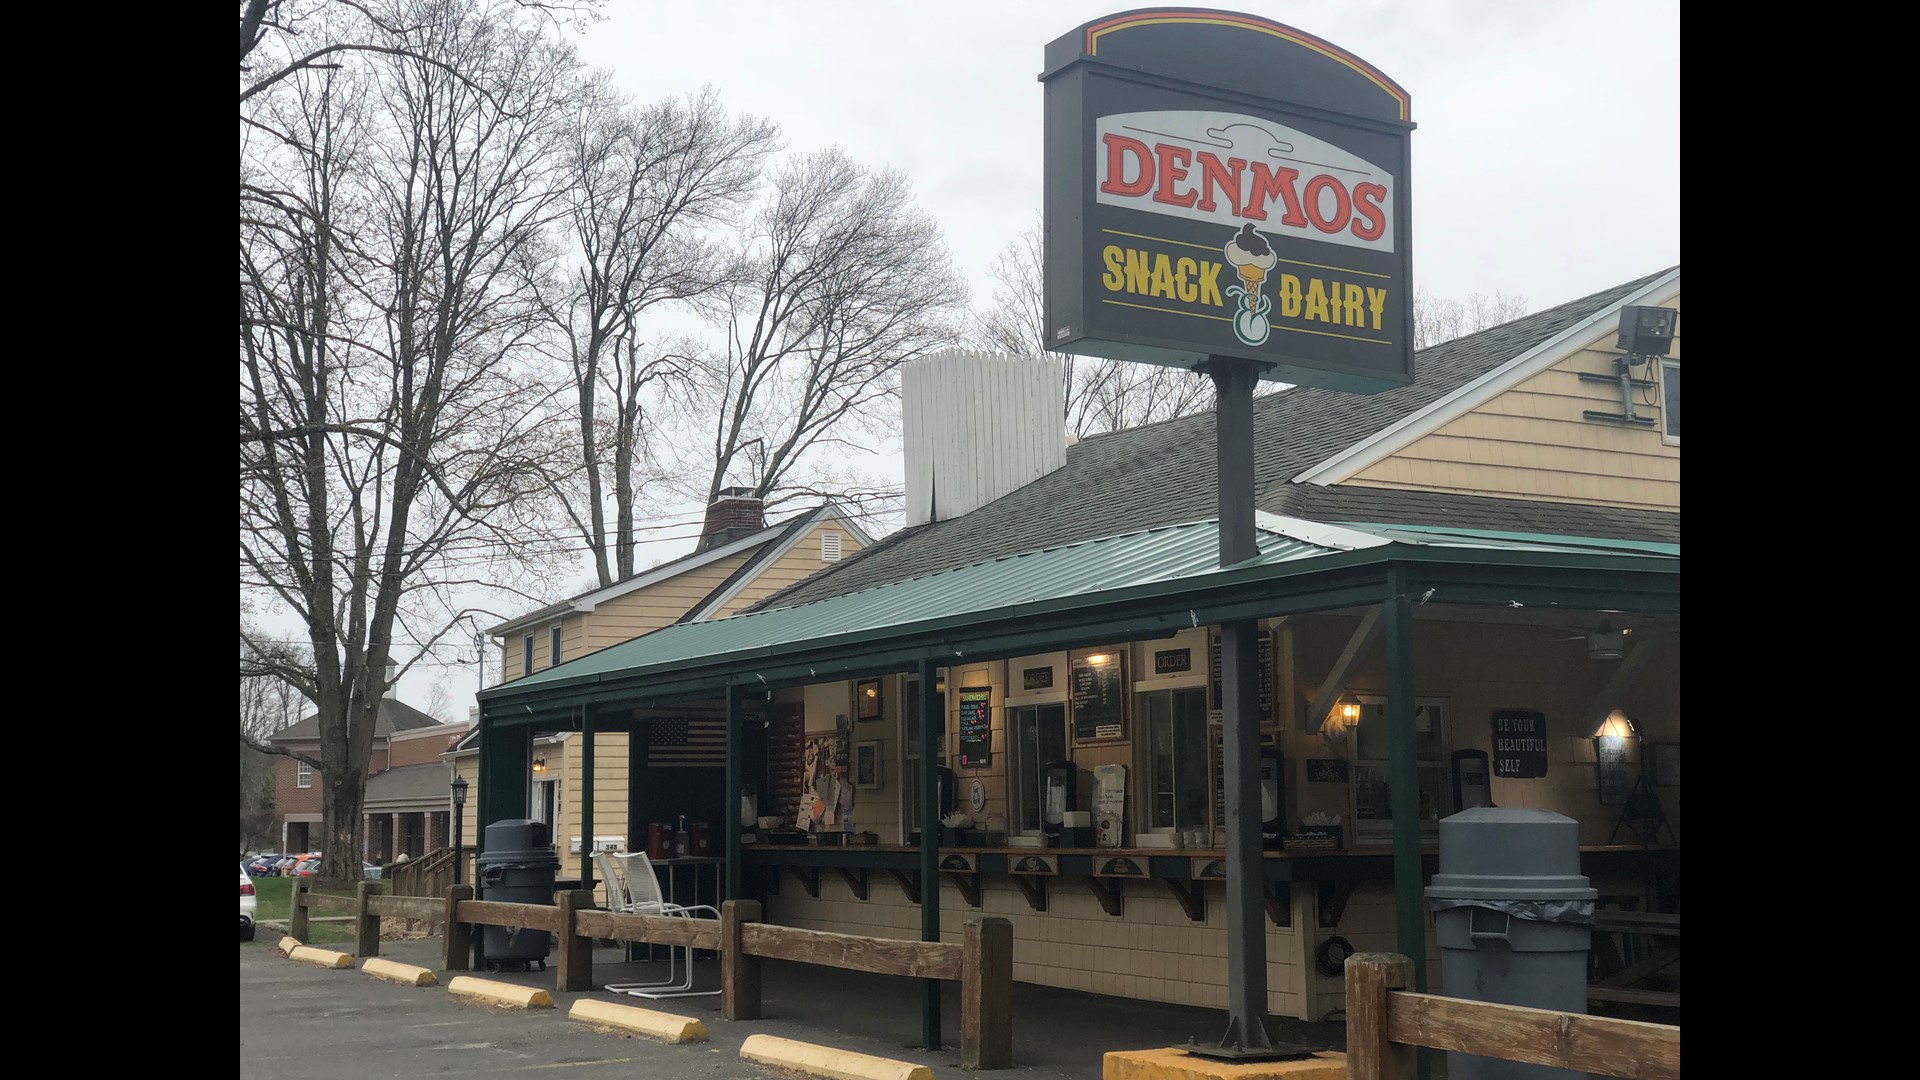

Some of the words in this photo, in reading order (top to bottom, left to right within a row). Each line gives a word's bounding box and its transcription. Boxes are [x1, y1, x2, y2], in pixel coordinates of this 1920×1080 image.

[1101, 133, 1387, 242] DENMOS
[1102, 244, 1224, 308] SNACK
[1279, 273, 1387, 331] DAIRY
[1157, 653, 1188, 669] ORDER
[1497, 718, 1510, 732] BE
[1512, 718, 1536, 732] YOUR
[1498, 738, 1546, 752] BEAUTIFUL
[1499, 759, 1521, 773] SELF
